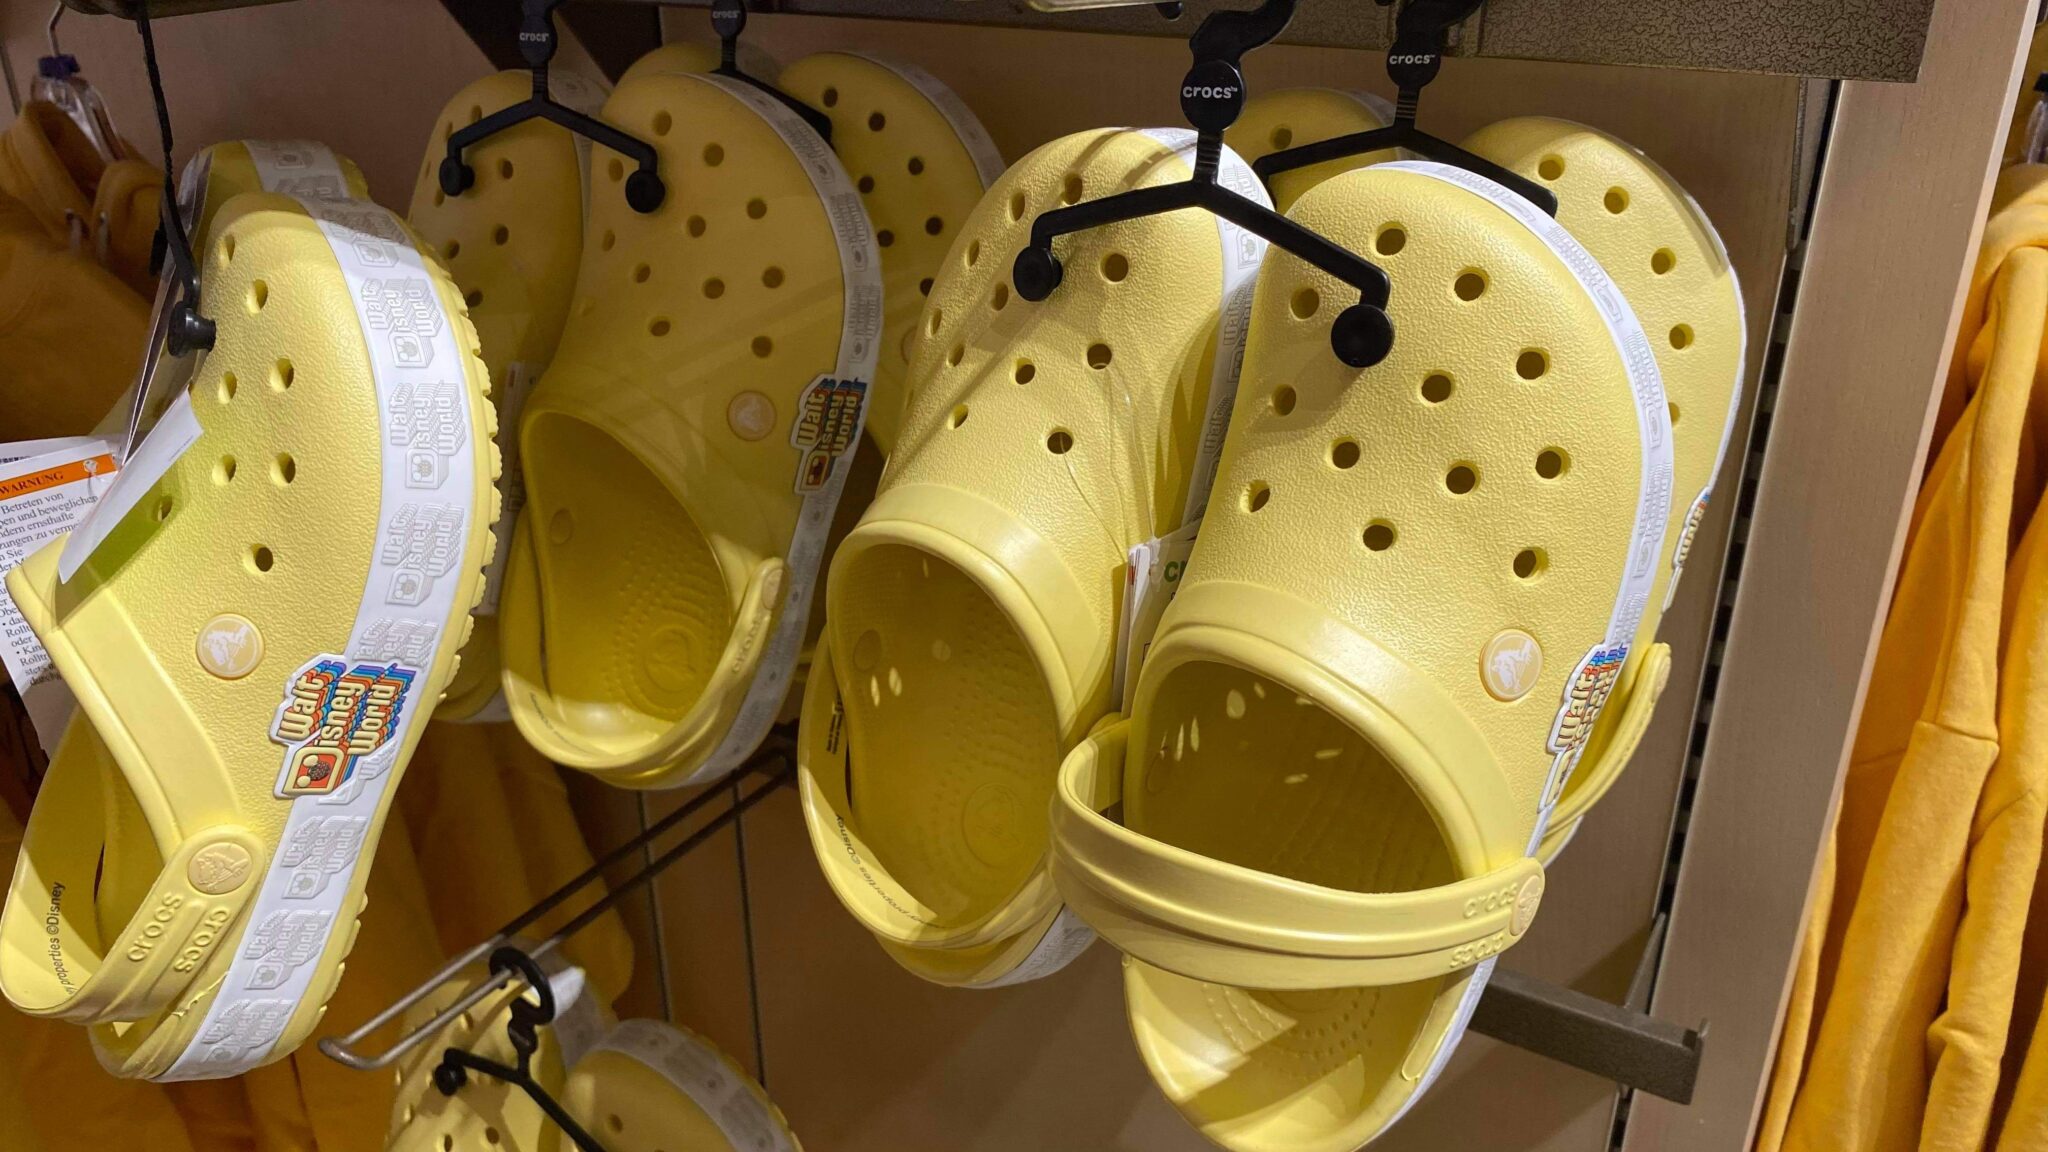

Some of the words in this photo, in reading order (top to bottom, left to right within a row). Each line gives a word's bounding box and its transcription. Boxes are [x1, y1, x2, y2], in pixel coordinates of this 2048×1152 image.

[1, 498, 44, 515] Betreten
[45, 492, 64, 503] von
[17, 508, 37, 522] und
[38, 495, 98, 517] beweglichen
[27, 512, 75, 530] ernsthafte
[36, 531, 48, 540] zu
[276, 674, 325, 742] Walt
[282, 681, 366, 796] Disney
[348, 683, 397, 756] World
[127, 891, 184, 962] crocs
[174, 906, 231, 974] crocs
